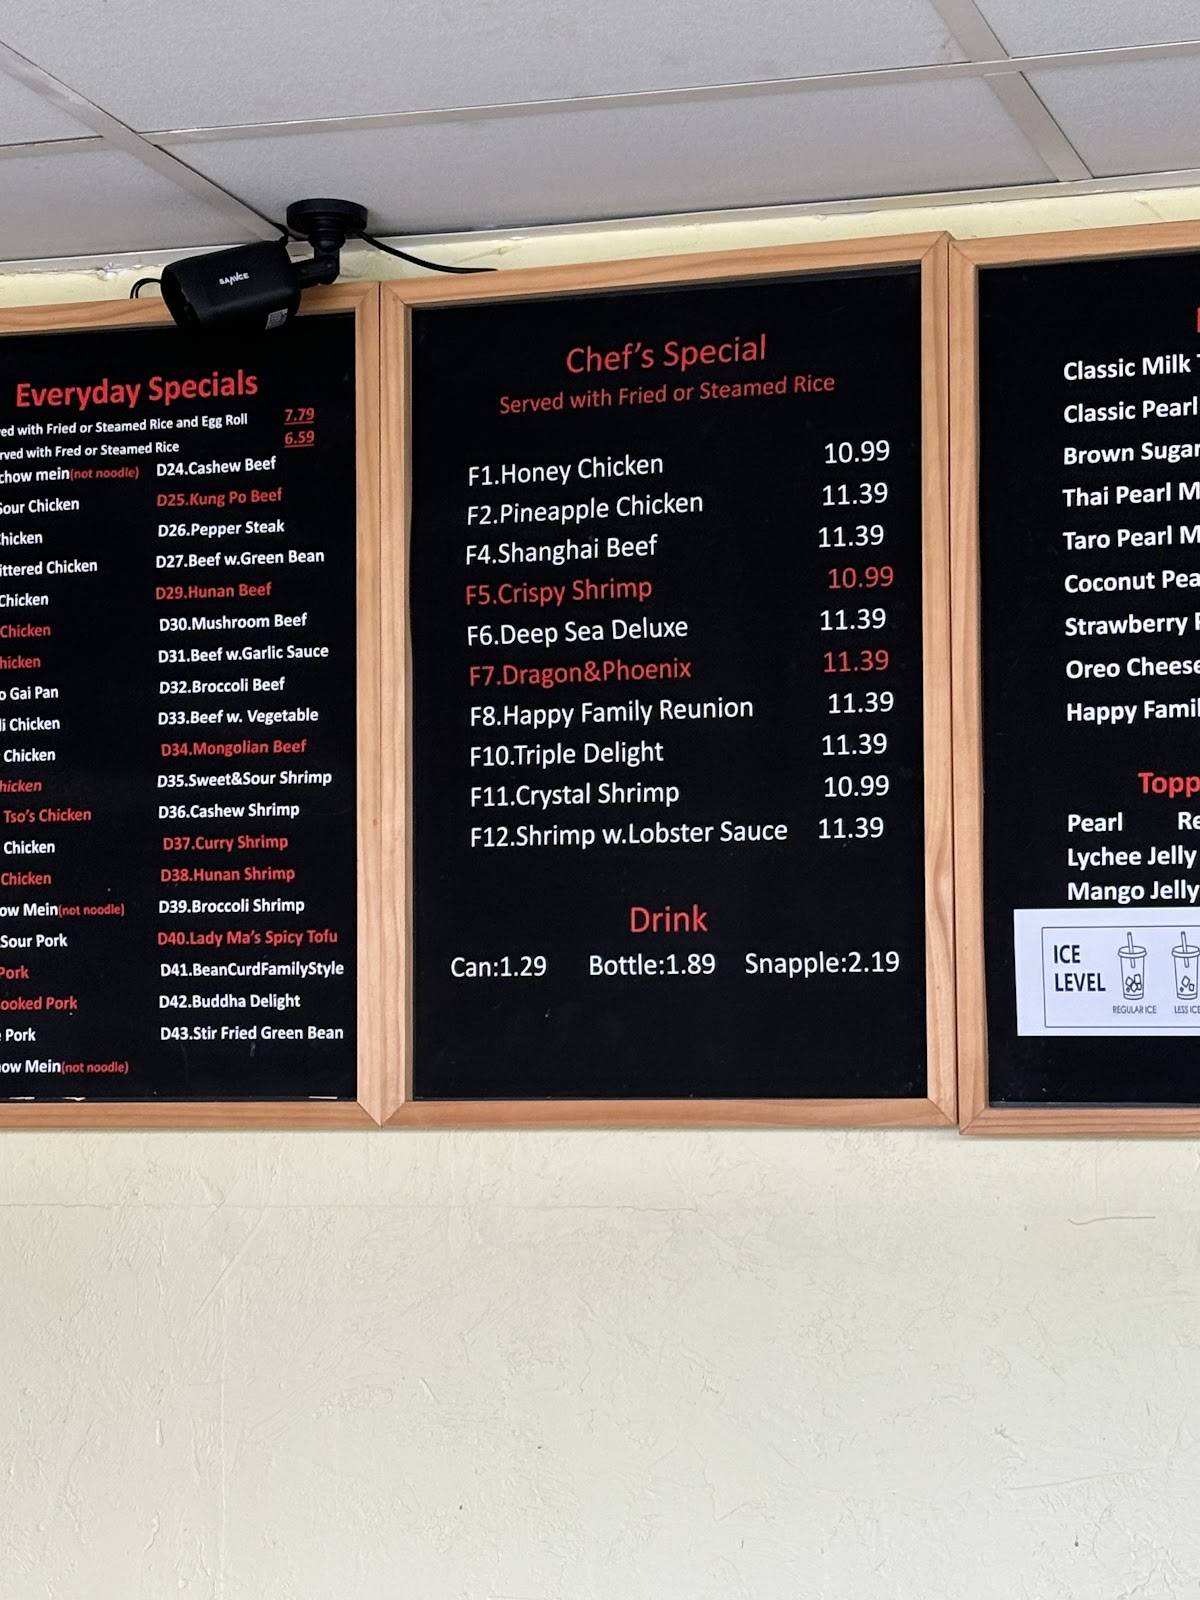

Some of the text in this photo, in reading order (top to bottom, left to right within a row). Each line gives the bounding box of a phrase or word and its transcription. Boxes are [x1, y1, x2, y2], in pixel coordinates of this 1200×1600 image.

[566, 334, 765, 372] Chef’s Special
[1063, 354, 1191, 380] Classic Milk
[16, 370, 257, 410] Everyday Specials
[500, 376, 834, 413] Served with Fried or Steamed Rice
[1063, 396, 1197, 423] Classic Pearl
[16, 408, 314, 436] with Fried or Steamed Rice and Egg Roll 7.79
[25, 431, 314, 459] with Fred or Steamed Rice 6.59
[468, 440, 889, 486] F1.Honey Chicken 10.99
[1063, 448, 1134, 465] Brown
[95, 467, 138, 478] noodle)
[156, 456, 276, 476] D24.Cashew Beef
[157, 488, 281, 507] D25.Kung Po Beef
[467, 482, 888, 525] F2.Pineapple Chicken 11.39
[1061, 486, 1108, 507] Thai
[1116, 482, 1171, 504] Pearl
[27, 498, 79, 512] Chicken
[157, 519, 284, 538] D26.Pepper Steak
[1062, 532, 1110, 550] Taro
[1117, 525, 1172, 547] Pearl
[466, 525, 883, 565] F4.Shanghai Beef 11.39
[46, 559, 97, 574] Chicken
[155, 550, 324, 568] D27.Beef w.Green Bean
[155, 582, 271, 599] D29.Hunan Beef
[466, 566, 893, 606] F5.Crispy Shrimp 10.99
[1064, 572, 1155, 593] Coconut
[0, 624, 50, 637] Chicken
[159, 612, 307, 631] D30.Mushroom Beef
[467, 608, 886, 647] F6.Deep Sea Deluxe 11.39
[1064, 614, 1188, 636] Strawberry
[158, 645, 329, 663] D31.Beef w.Garlic Sauce
[470, 650, 888, 688] F7.Dragon&Phoenix 11.39
[1065, 660, 1120, 678] Oreo
[9, 686, 31, 700] Gai
[34, 686, 58, 699] Pan
[159, 676, 285, 694] D32.Broccoli Beef
[157, 708, 318, 725] D33.Beef w. Vegetable
[470, 692, 894, 729] F8.Happy Family Reunion 11.39
[1066, 703, 1137, 725] Happy
[9, 717, 60, 731] Chicken
[3, 748, 55, 762] Chicken
[161, 739, 306, 757] D34.Mongolian Beef
[470, 733, 887, 769] F10.Triple Delight 11.39
[156, 770, 332, 787] D35.Sweet&Sour Shrimp
[470, 775, 889, 810] F11.Crystal Shrimp 10.99
[38, 808, 91, 821] Chicken
[158, 802, 299, 819] D36.Cashew Shrimp
[1067, 812, 1122, 832] Pearl
[470, 817, 883, 849] F12.Shrimp w.Lobster Sauce 11.39
[3, 840, 55, 854] Chicken
[163, 835, 288, 851] D37.Curry Shrimp
[1067, 845, 1197, 870] Lychee Jelly
[0, 872, 51, 885] Chicken
[160, 867, 295, 882] D38.Hunan Shrimp
[1067, 880, 1200, 904] Mango Jelly
[83, 904, 124, 916] noodle)
[158, 898, 304, 914] D39.Broccoli Shrimp
[630, 904, 707, 932] Drink
[35, 933, 68, 947] Pork
[157, 931, 222, 947] D40.Lady
[264, 930, 303, 946] Spicy
[306, 929, 337, 943] Tofu
[1053, 945, 1080, 963] ICE
[160, 961, 344, 978] D41.BeanCurdFamilyStyle
[450, 951, 899, 978] Can:1.29 Bottle:1.89 Snapple:2.19
[1054, 973, 1105, 991] LEVEL
[45, 996, 78, 1009] Pork
[158, 993, 300, 1010] D42.Buddha Delight
[1111, 1005, 1157, 1014] REGULAR ICE
[1173, 1005, 1189, 1014] LESS
[5, 1028, 35, 1041] Pork
[160, 1026, 343, 1040] D43.Stir Fried Green Bean
[86, 1061, 128, 1074] noodle)
